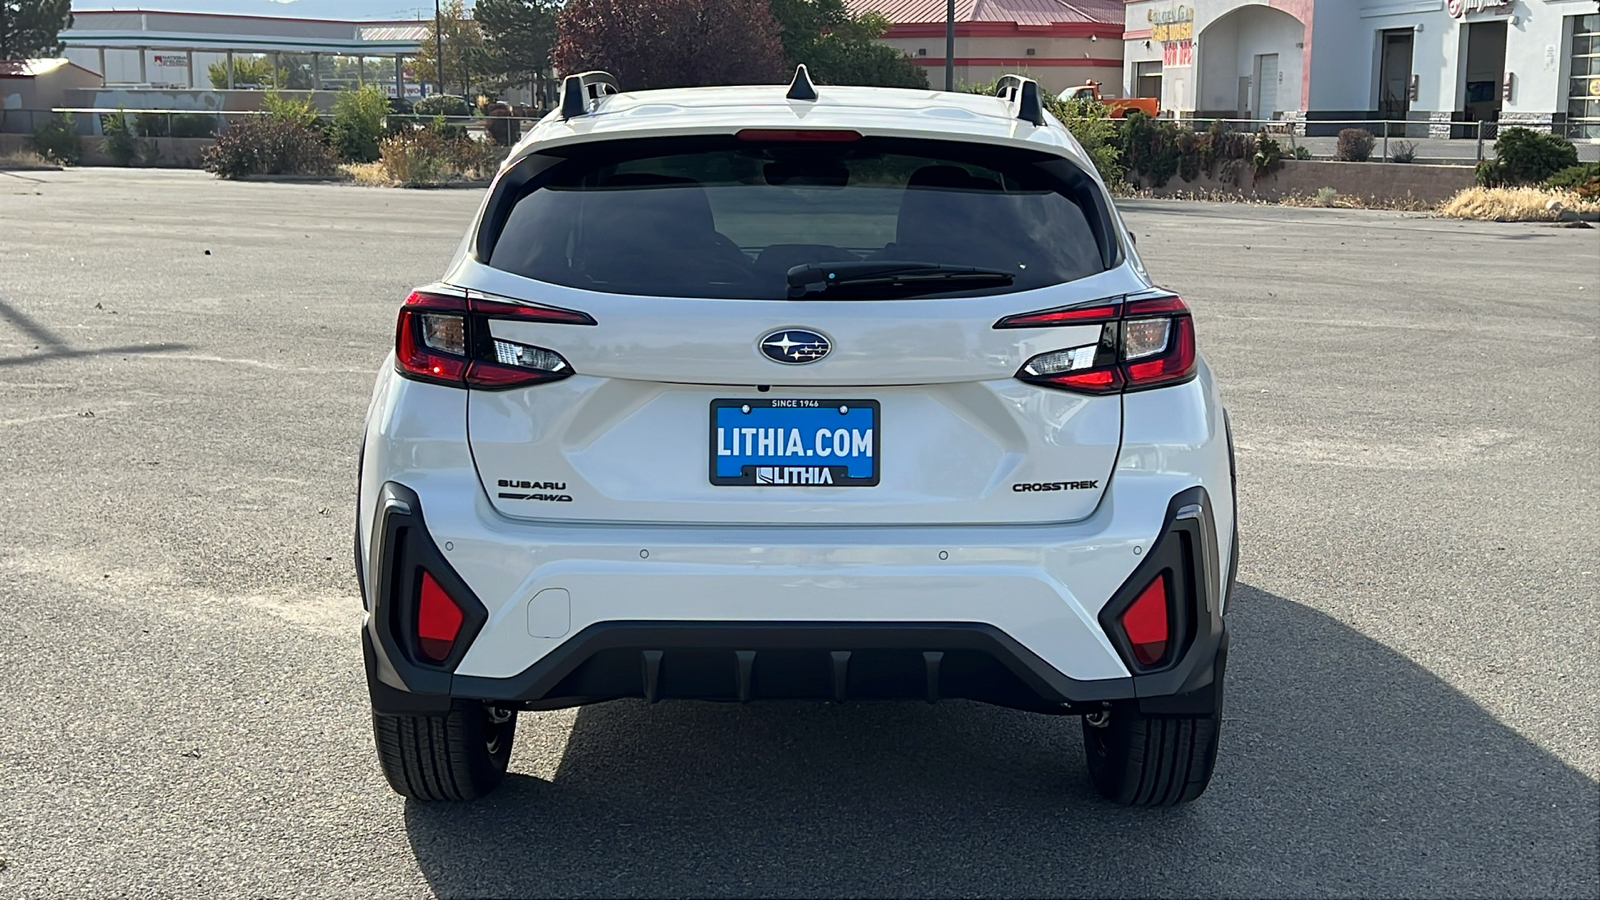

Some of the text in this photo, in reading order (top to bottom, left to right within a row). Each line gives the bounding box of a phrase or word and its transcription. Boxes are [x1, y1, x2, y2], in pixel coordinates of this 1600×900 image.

[771, 399, 819, 408] SINCE 1946
[717, 427, 873, 457] LITHIA.COM
[773, 467, 833, 484] LITHIA
[497, 479, 566, 490] SUBARU
[1012, 480, 1099, 492] CROSSTREK
[526, 493, 574, 502] AWD
